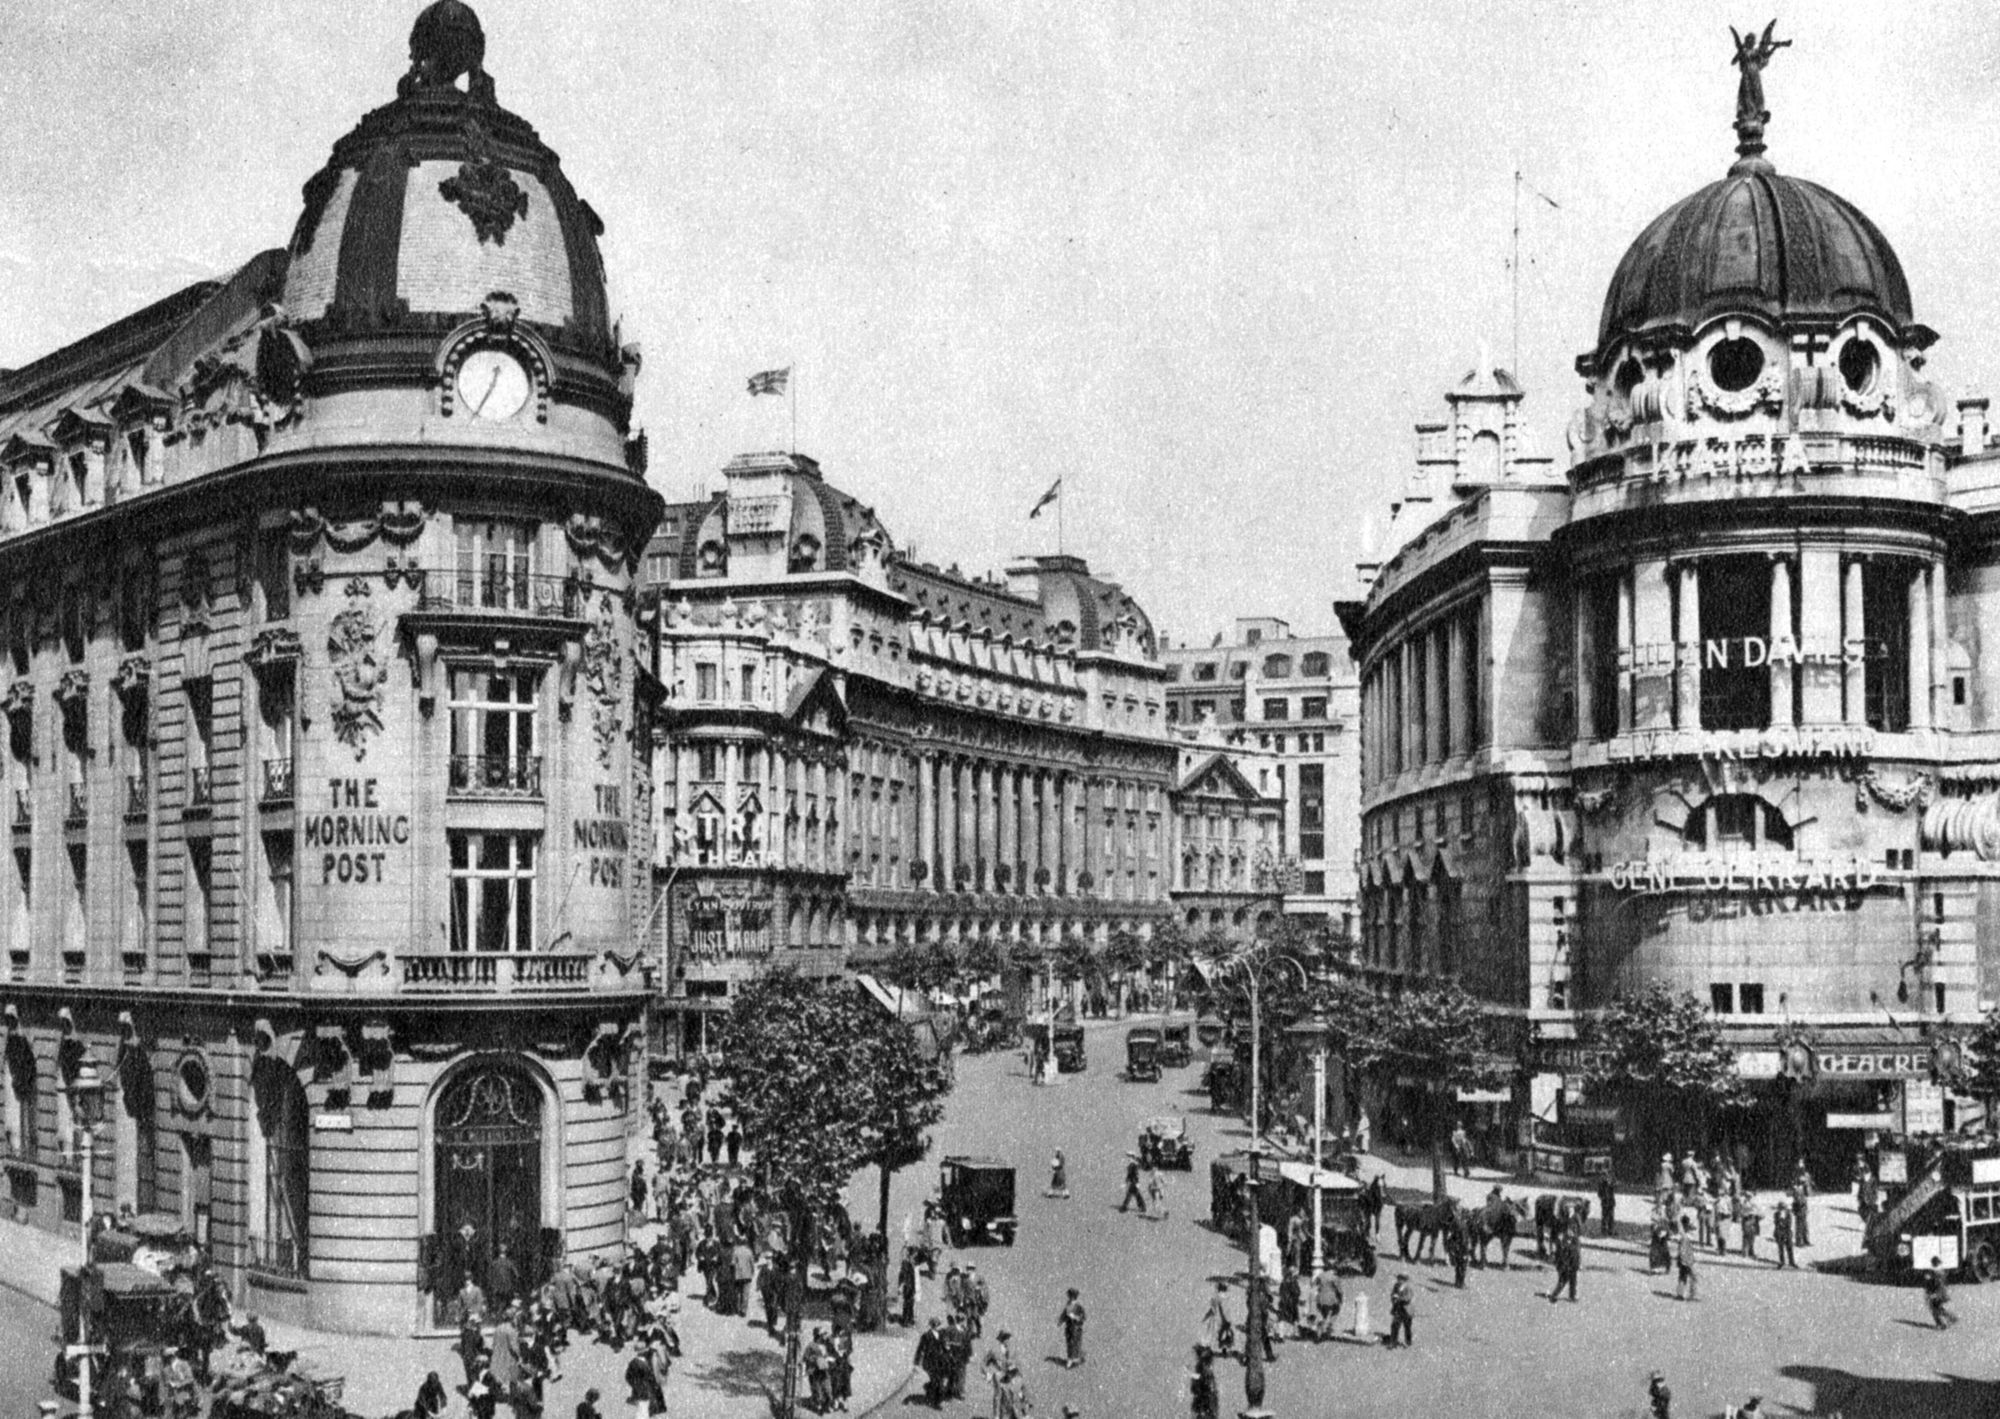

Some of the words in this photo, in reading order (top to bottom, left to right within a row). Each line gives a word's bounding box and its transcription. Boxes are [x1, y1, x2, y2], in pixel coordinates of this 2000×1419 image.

[1743, 635, 1864, 671] DAVIES
[328, 778, 378, 808] THE
[594, 784, 621, 817] THE
[304, 814, 409, 847] MORNING
[322, 852, 386, 884] POST
[1703, 857, 1877, 890] GERRARD
[691, 929, 724, 953] JUST
